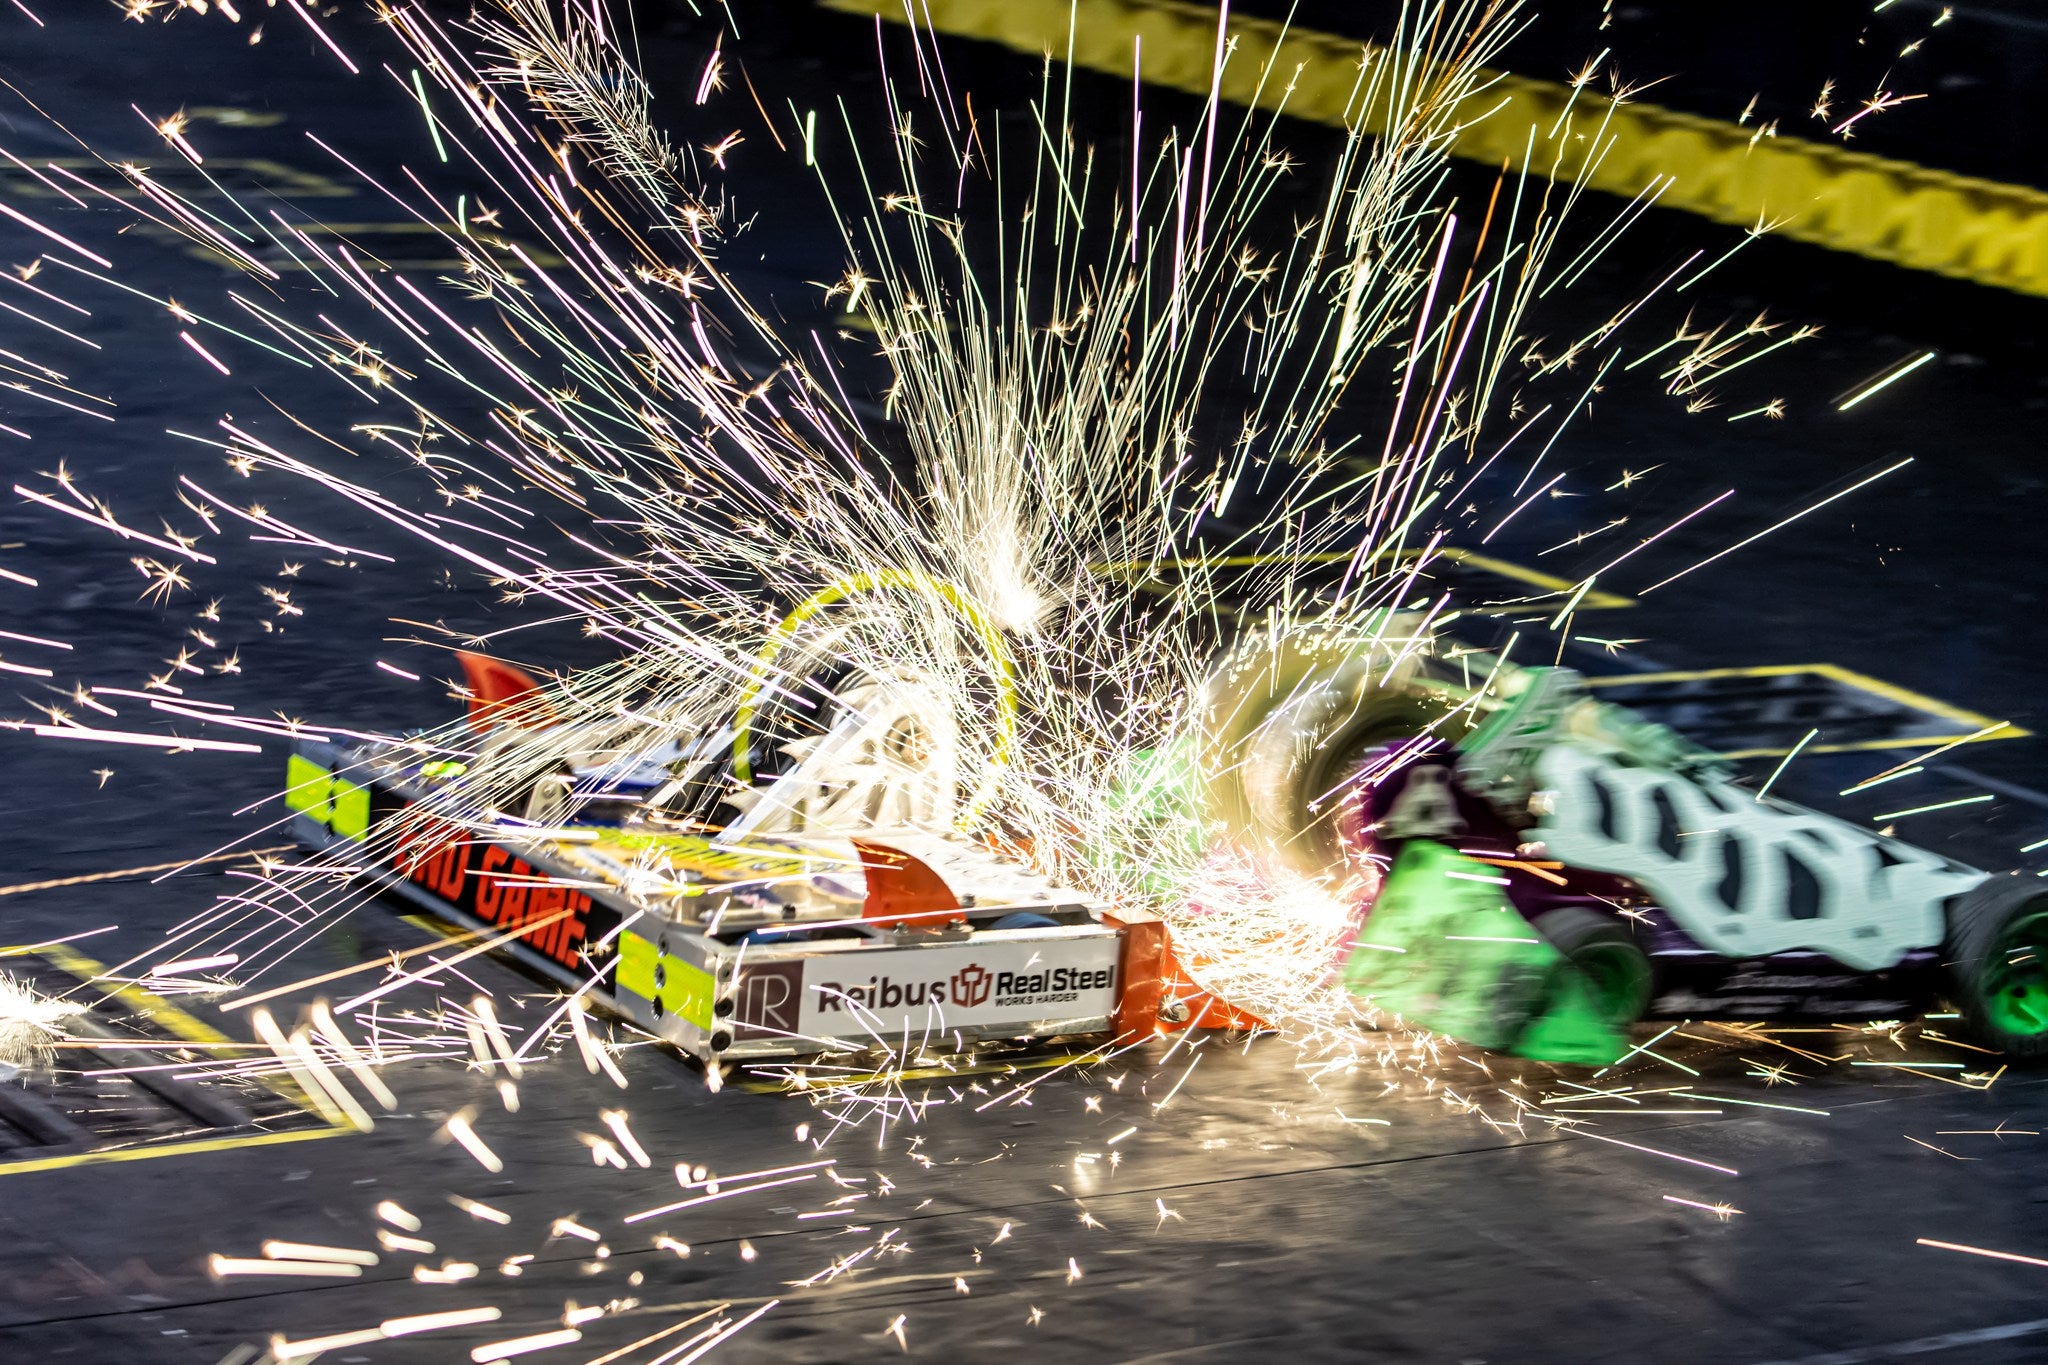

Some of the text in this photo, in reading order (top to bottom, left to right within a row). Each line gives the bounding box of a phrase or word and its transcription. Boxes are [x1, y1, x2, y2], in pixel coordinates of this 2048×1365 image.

[475, 843, 592, 970] GAME
[817, 976, 946, 1013] Reibus
[995, 992, 1079, 1007] WORKS HARDER
